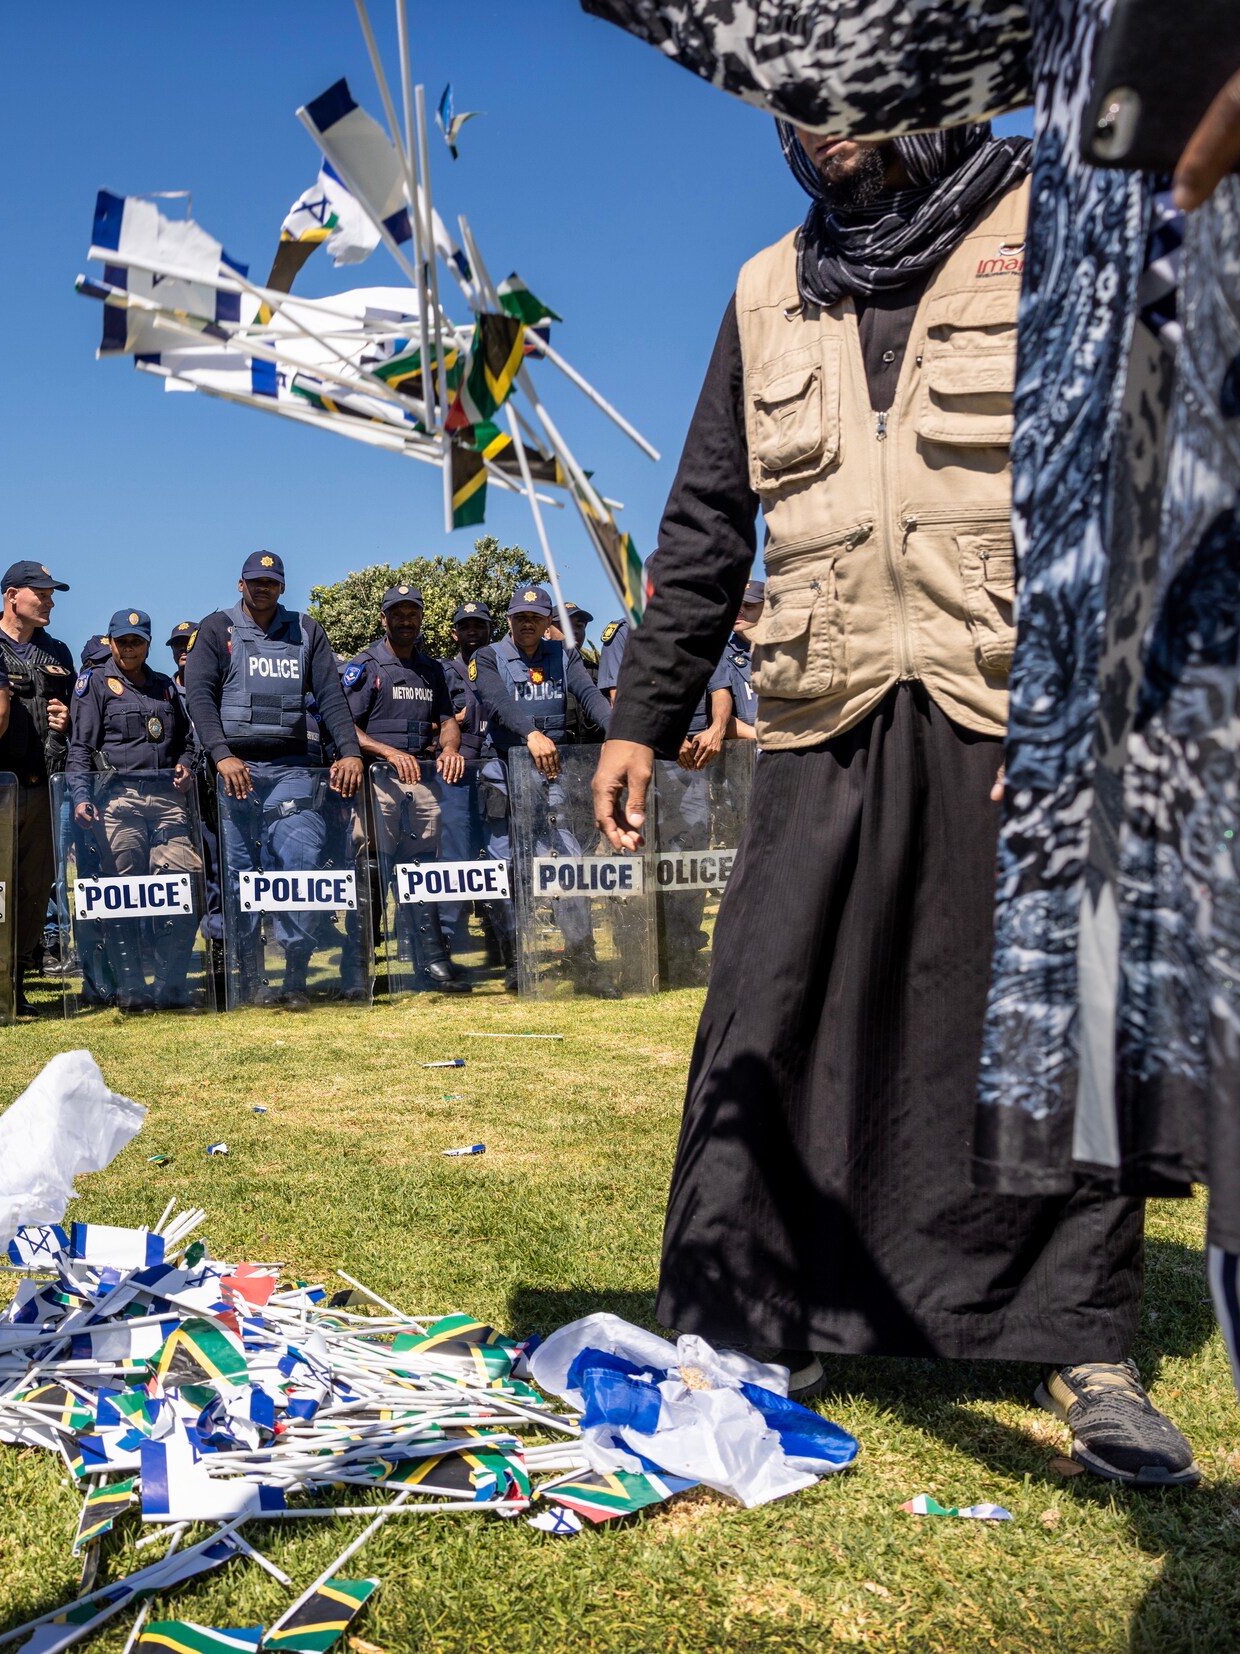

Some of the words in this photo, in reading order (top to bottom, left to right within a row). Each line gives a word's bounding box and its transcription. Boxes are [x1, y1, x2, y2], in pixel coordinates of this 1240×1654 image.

[249, 656, 300, 679] POLICE
[392, 686, 415, 700] METRO
[415, 687, 433, 701] POLICE
[515, 679, 563, 701] POLICE
[408, 868, 498, 895] POLICE
[539, 863, 633, 891] POLICE
[657, 856, 733, 886] OLICE
[85, 882, 181, 911] POLICE
[254, 877, 347, 903] POLICE
